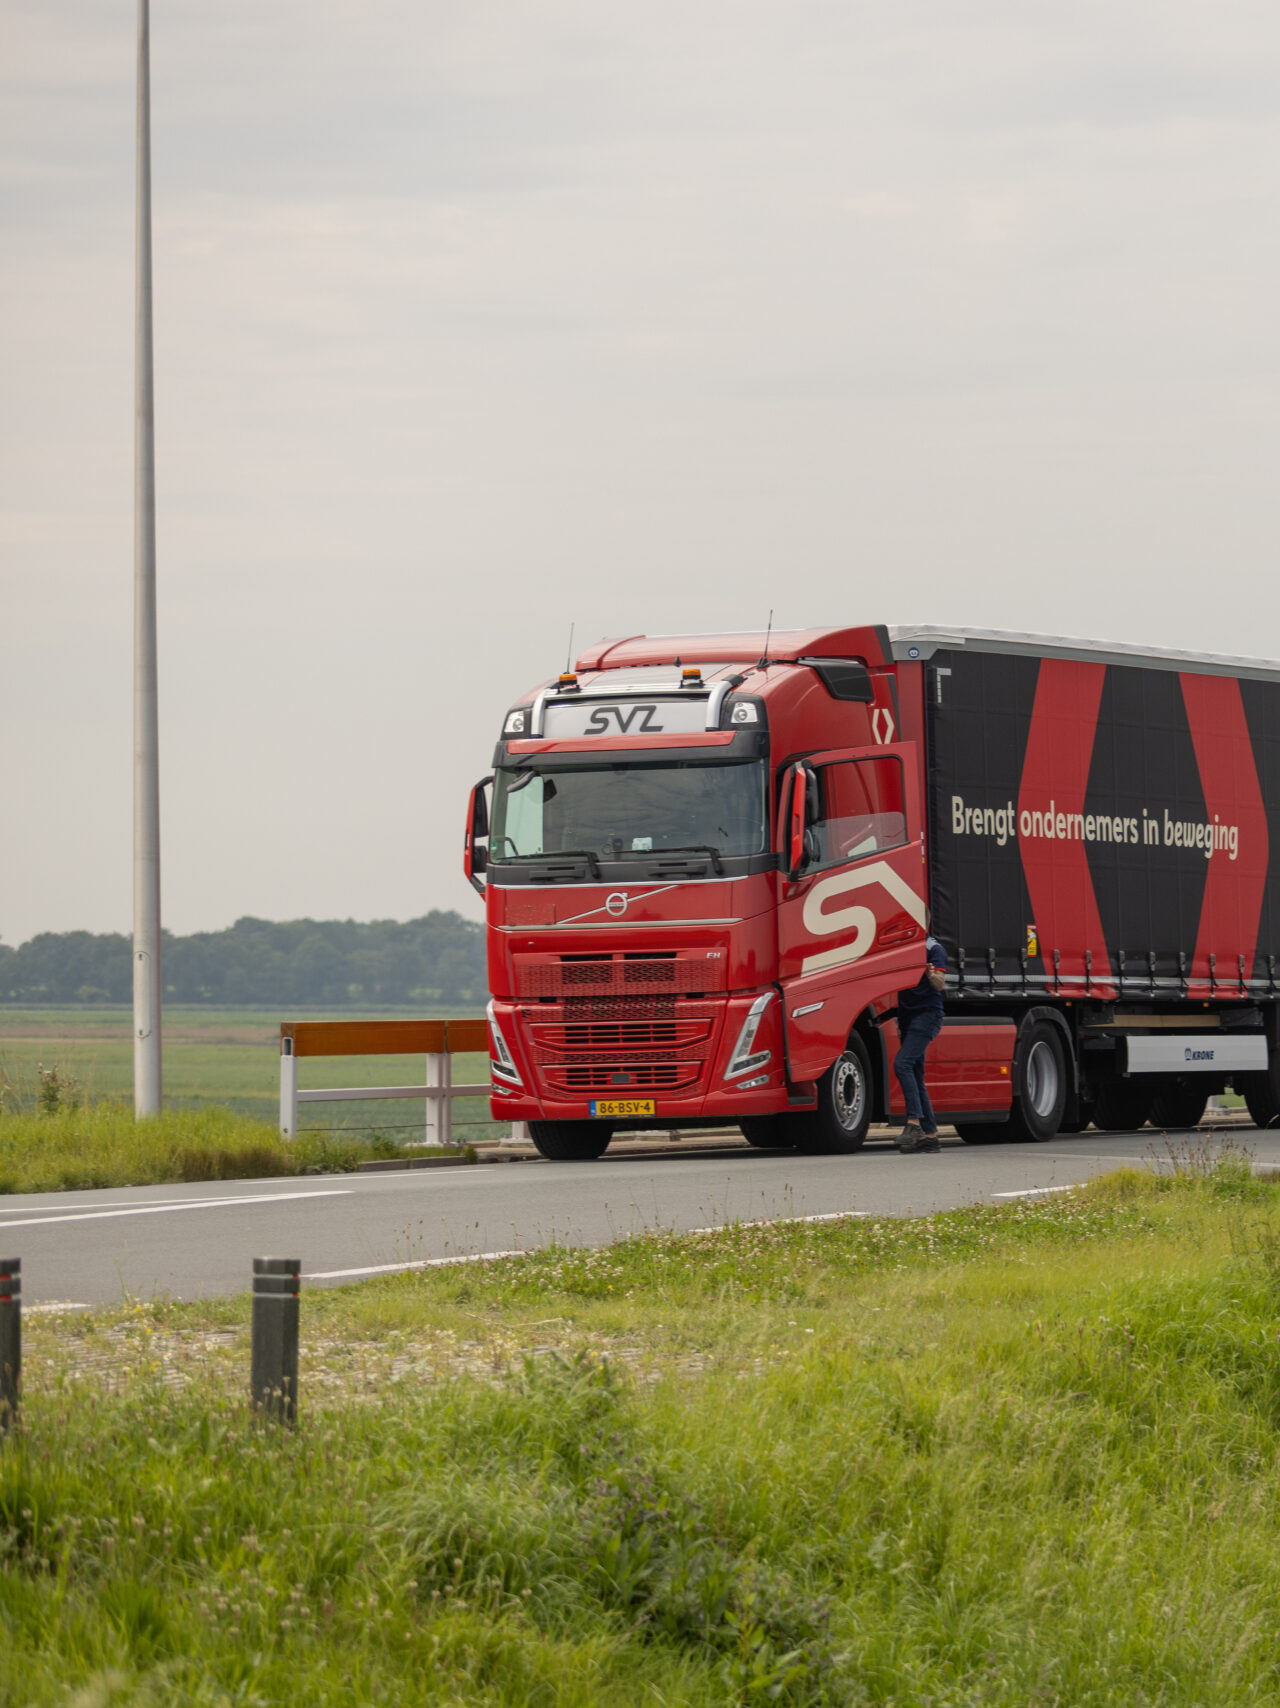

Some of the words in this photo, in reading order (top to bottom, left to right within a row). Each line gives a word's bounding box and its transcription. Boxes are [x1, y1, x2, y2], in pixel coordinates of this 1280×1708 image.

[583, 705, 664, 735] SVZ
[951, 795, 1016, 846] Brengt
[1020, 799, 1139, 844] ondernemers
[1142, 808, 1159, 845] in
[1163, 808, 1239, 860] beweging
[600, 1102, 650, 1113] 86-BSV-4
